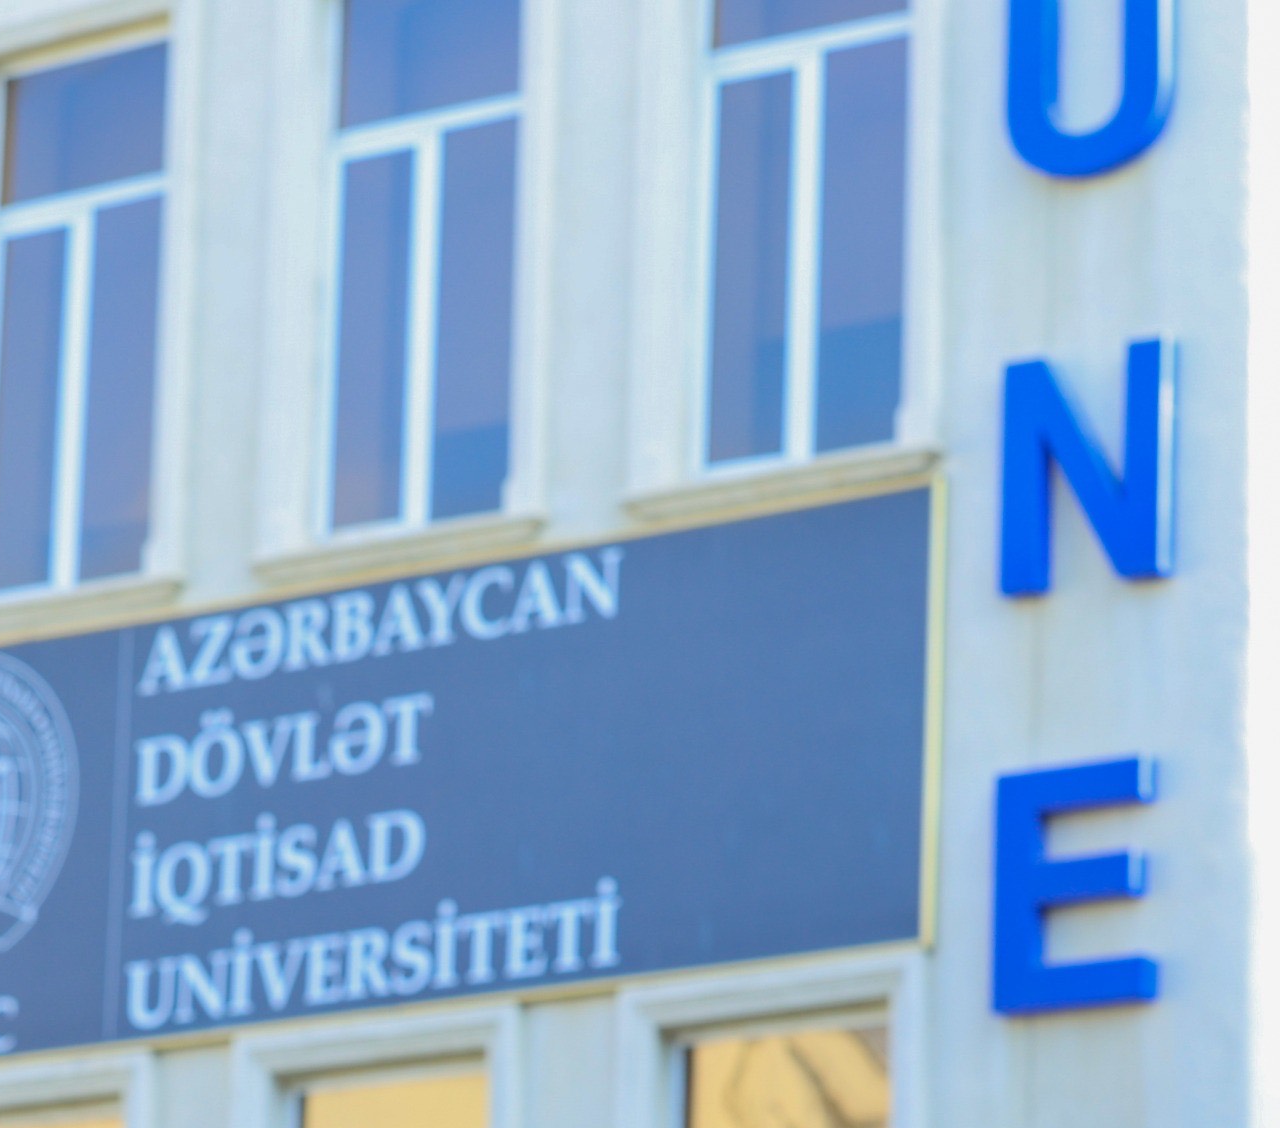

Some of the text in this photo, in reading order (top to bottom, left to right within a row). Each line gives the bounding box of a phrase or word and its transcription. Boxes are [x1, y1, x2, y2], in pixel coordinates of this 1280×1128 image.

[135, 547, 623, 696] AZƏRBAYCAN
[135, 692, 434, 806] DÖVLƏT
[128, 808, 426, 925] İQTİSAD
[125, 876, 620, 1030] UNİVERSİTETİ
